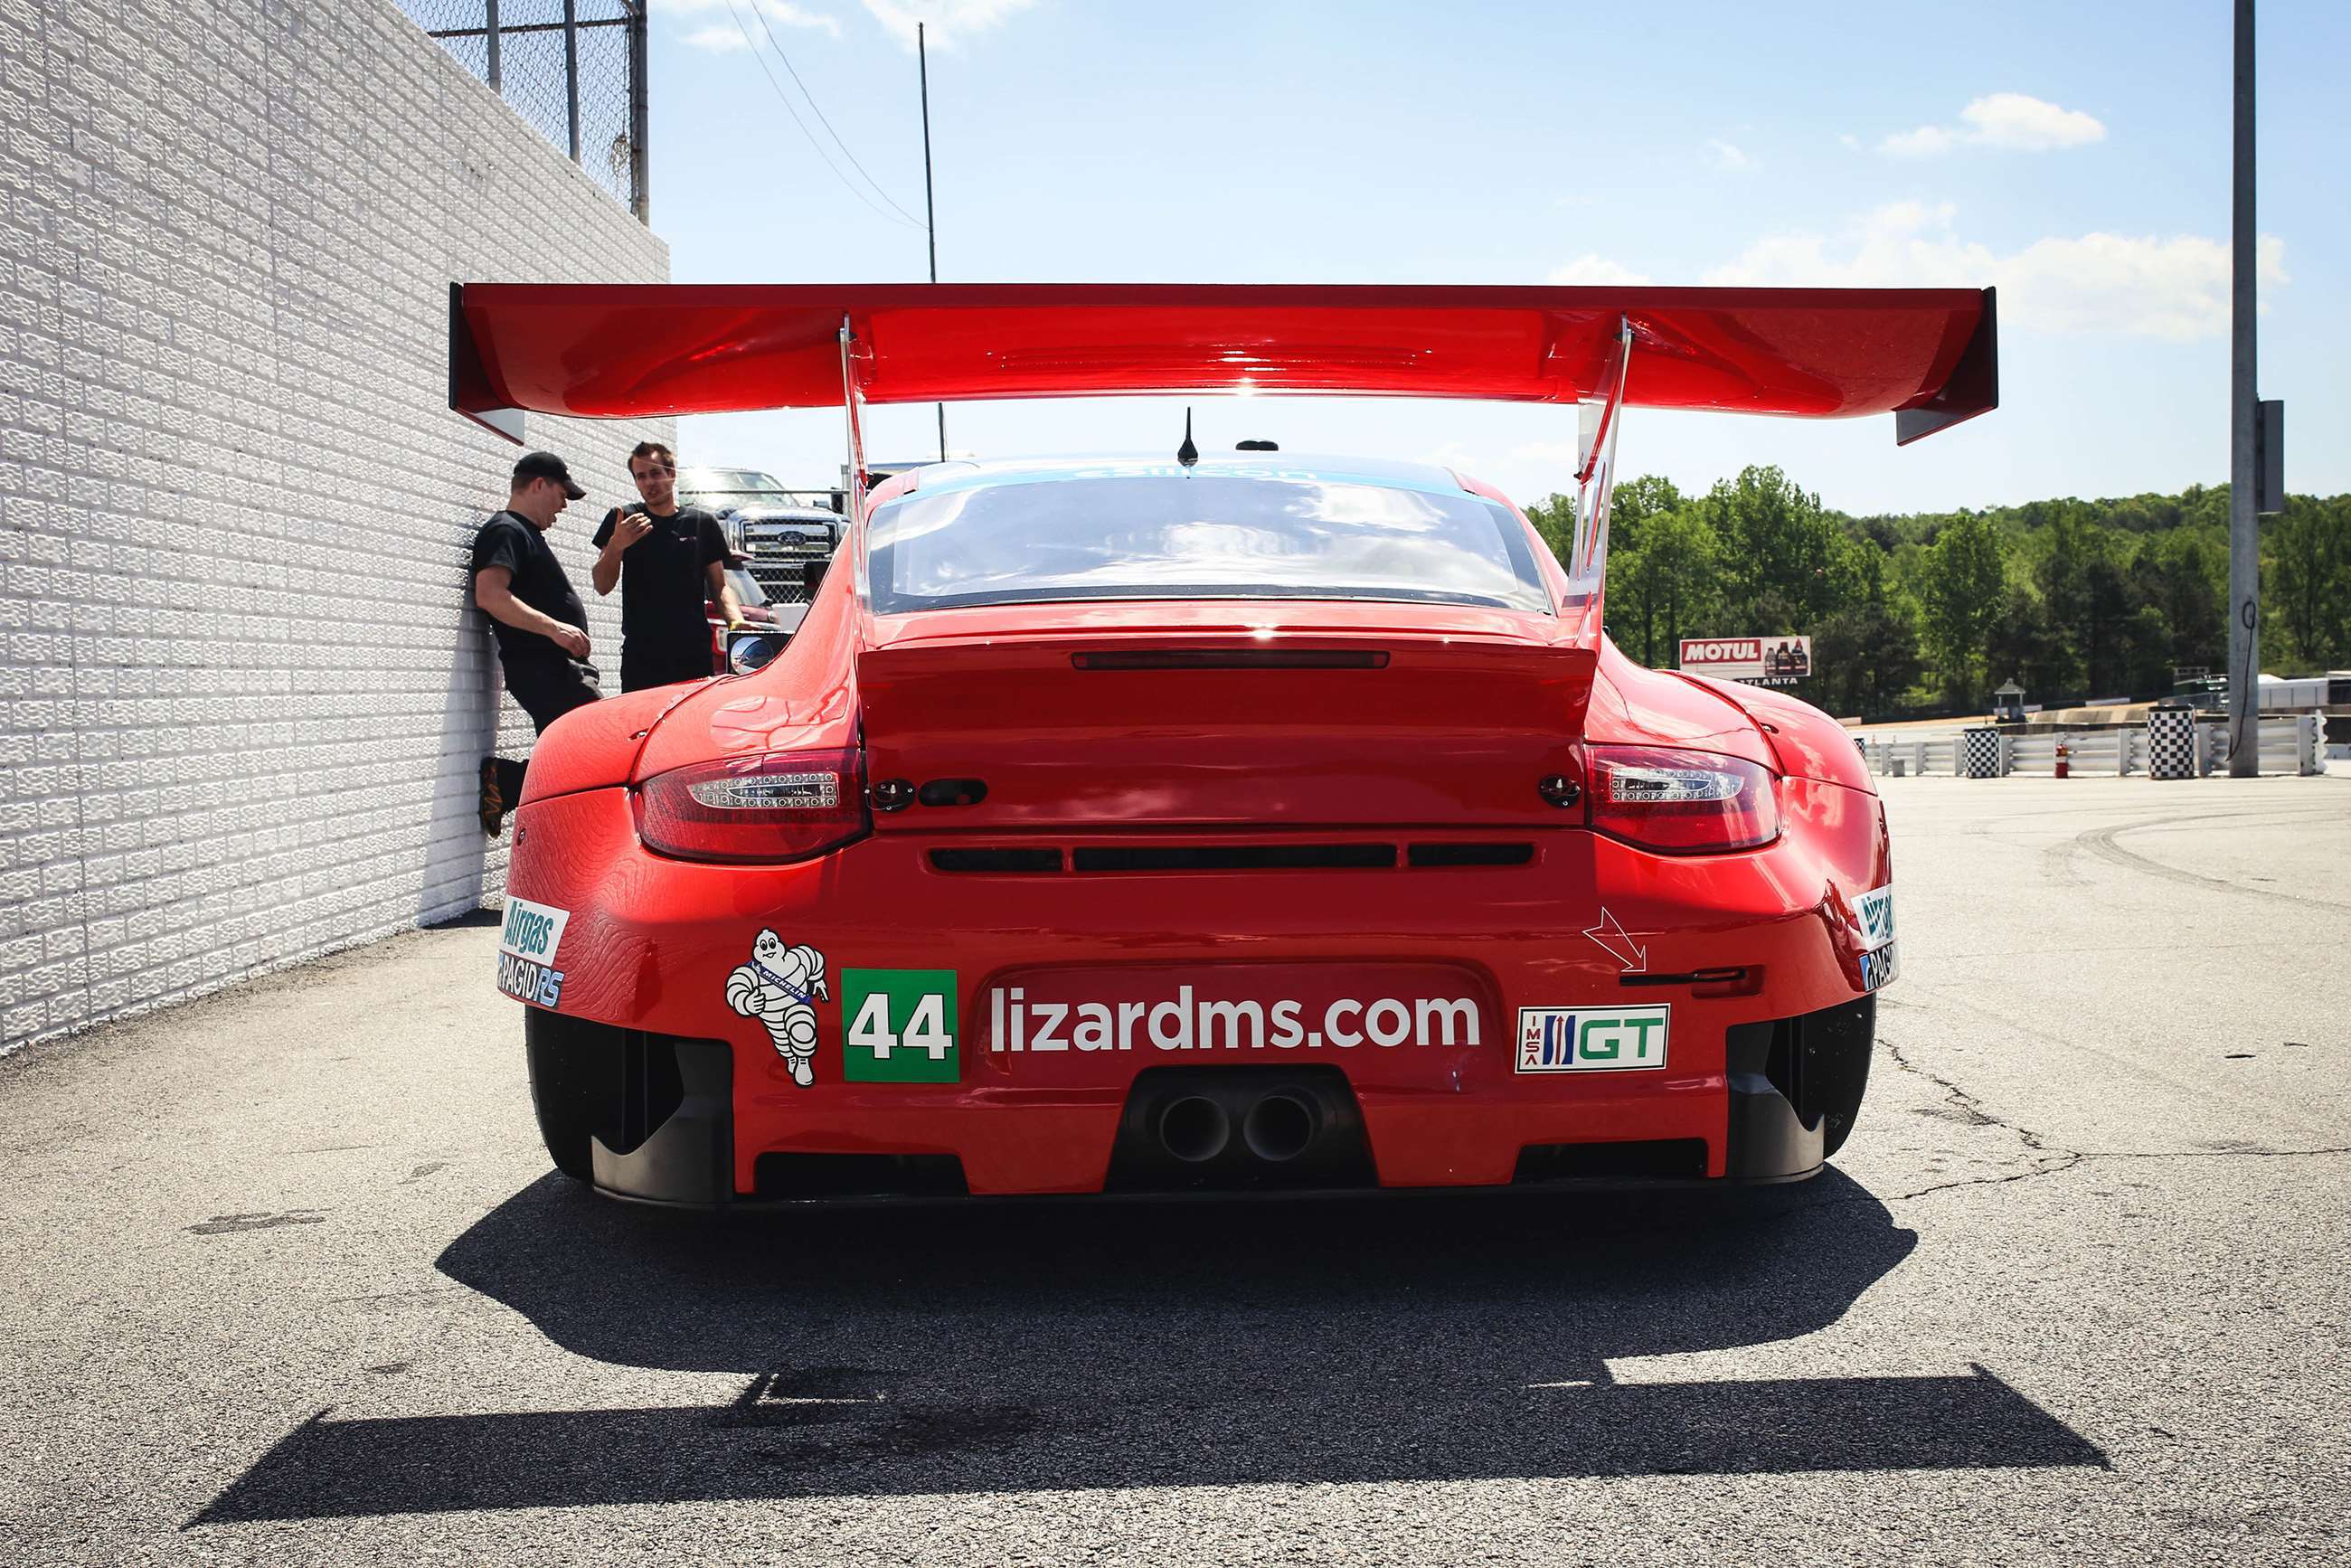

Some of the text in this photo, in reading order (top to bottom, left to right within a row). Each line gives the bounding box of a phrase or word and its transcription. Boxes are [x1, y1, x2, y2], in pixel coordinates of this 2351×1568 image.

[1685, 642, 1759, 661] MOTUL
[504, 901, 554, 955] Airgas
[502, 952, 537, 999] PAGID
[763, 970, 807, 998] MICHELIN
[847, 992, 953, 1060] 44
[991, 985, 1480, 1053] lizardms.com
[1525, 1015, 1541, 1065] IMSA
[1579, 1017, 1664, 1060] GT
